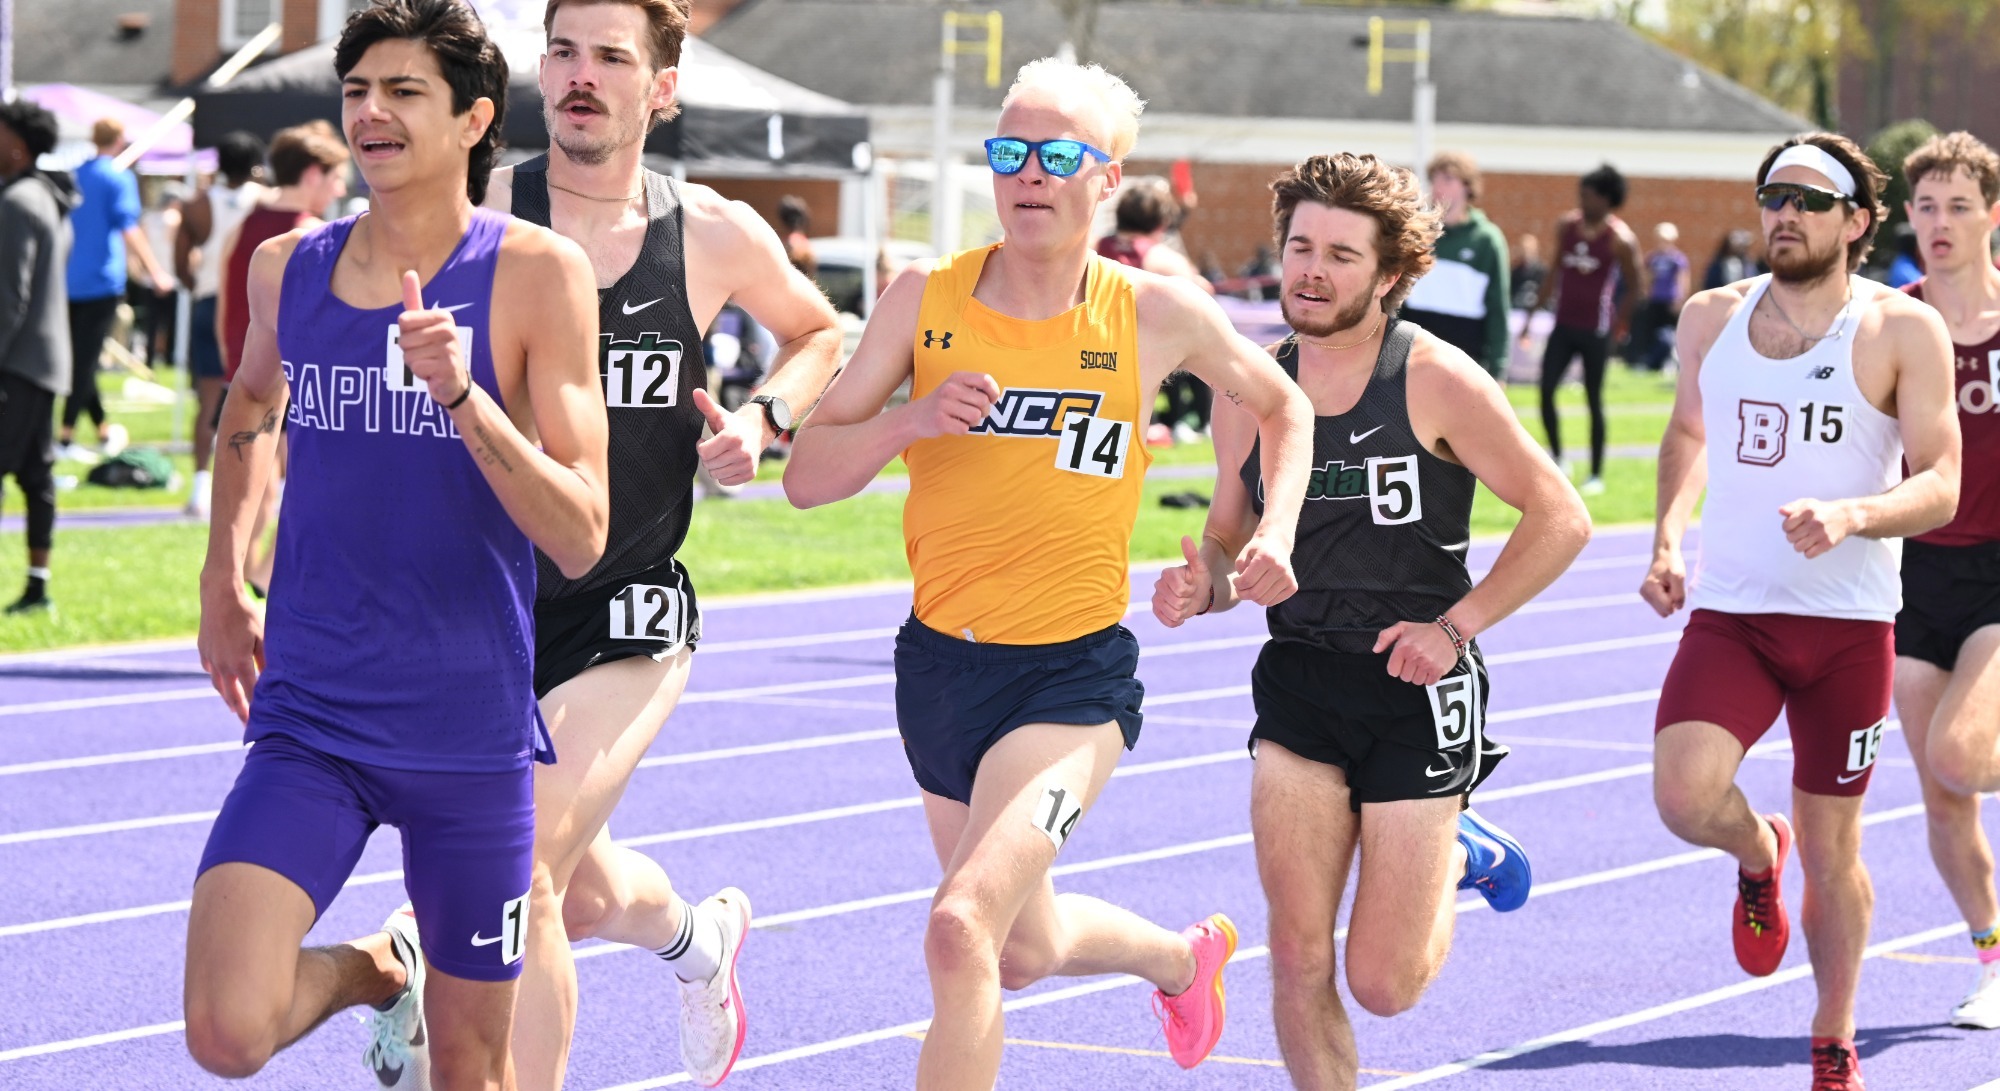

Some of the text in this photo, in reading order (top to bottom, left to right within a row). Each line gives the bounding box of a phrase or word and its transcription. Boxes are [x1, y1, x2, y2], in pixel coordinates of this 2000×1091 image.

[613, 352, 671, 404] 12
[1080, 350, 1117, 372] SOCON
[281, 361, 463, 439] CAPITA
[970, 389, 1103, 437] NCG
[1799, 402, 1843, 443] 15
[1068, 417, 1123, 475] 14
[1737, 398, 1789, 467] B
[1376, 462, 1413, 520] 5
[614, 586, 670, 639] 12
[1436, 680, 1467, 741] 5
[1855, 722, 1883, 767] 15
[508, 898, 528, 956] 1
